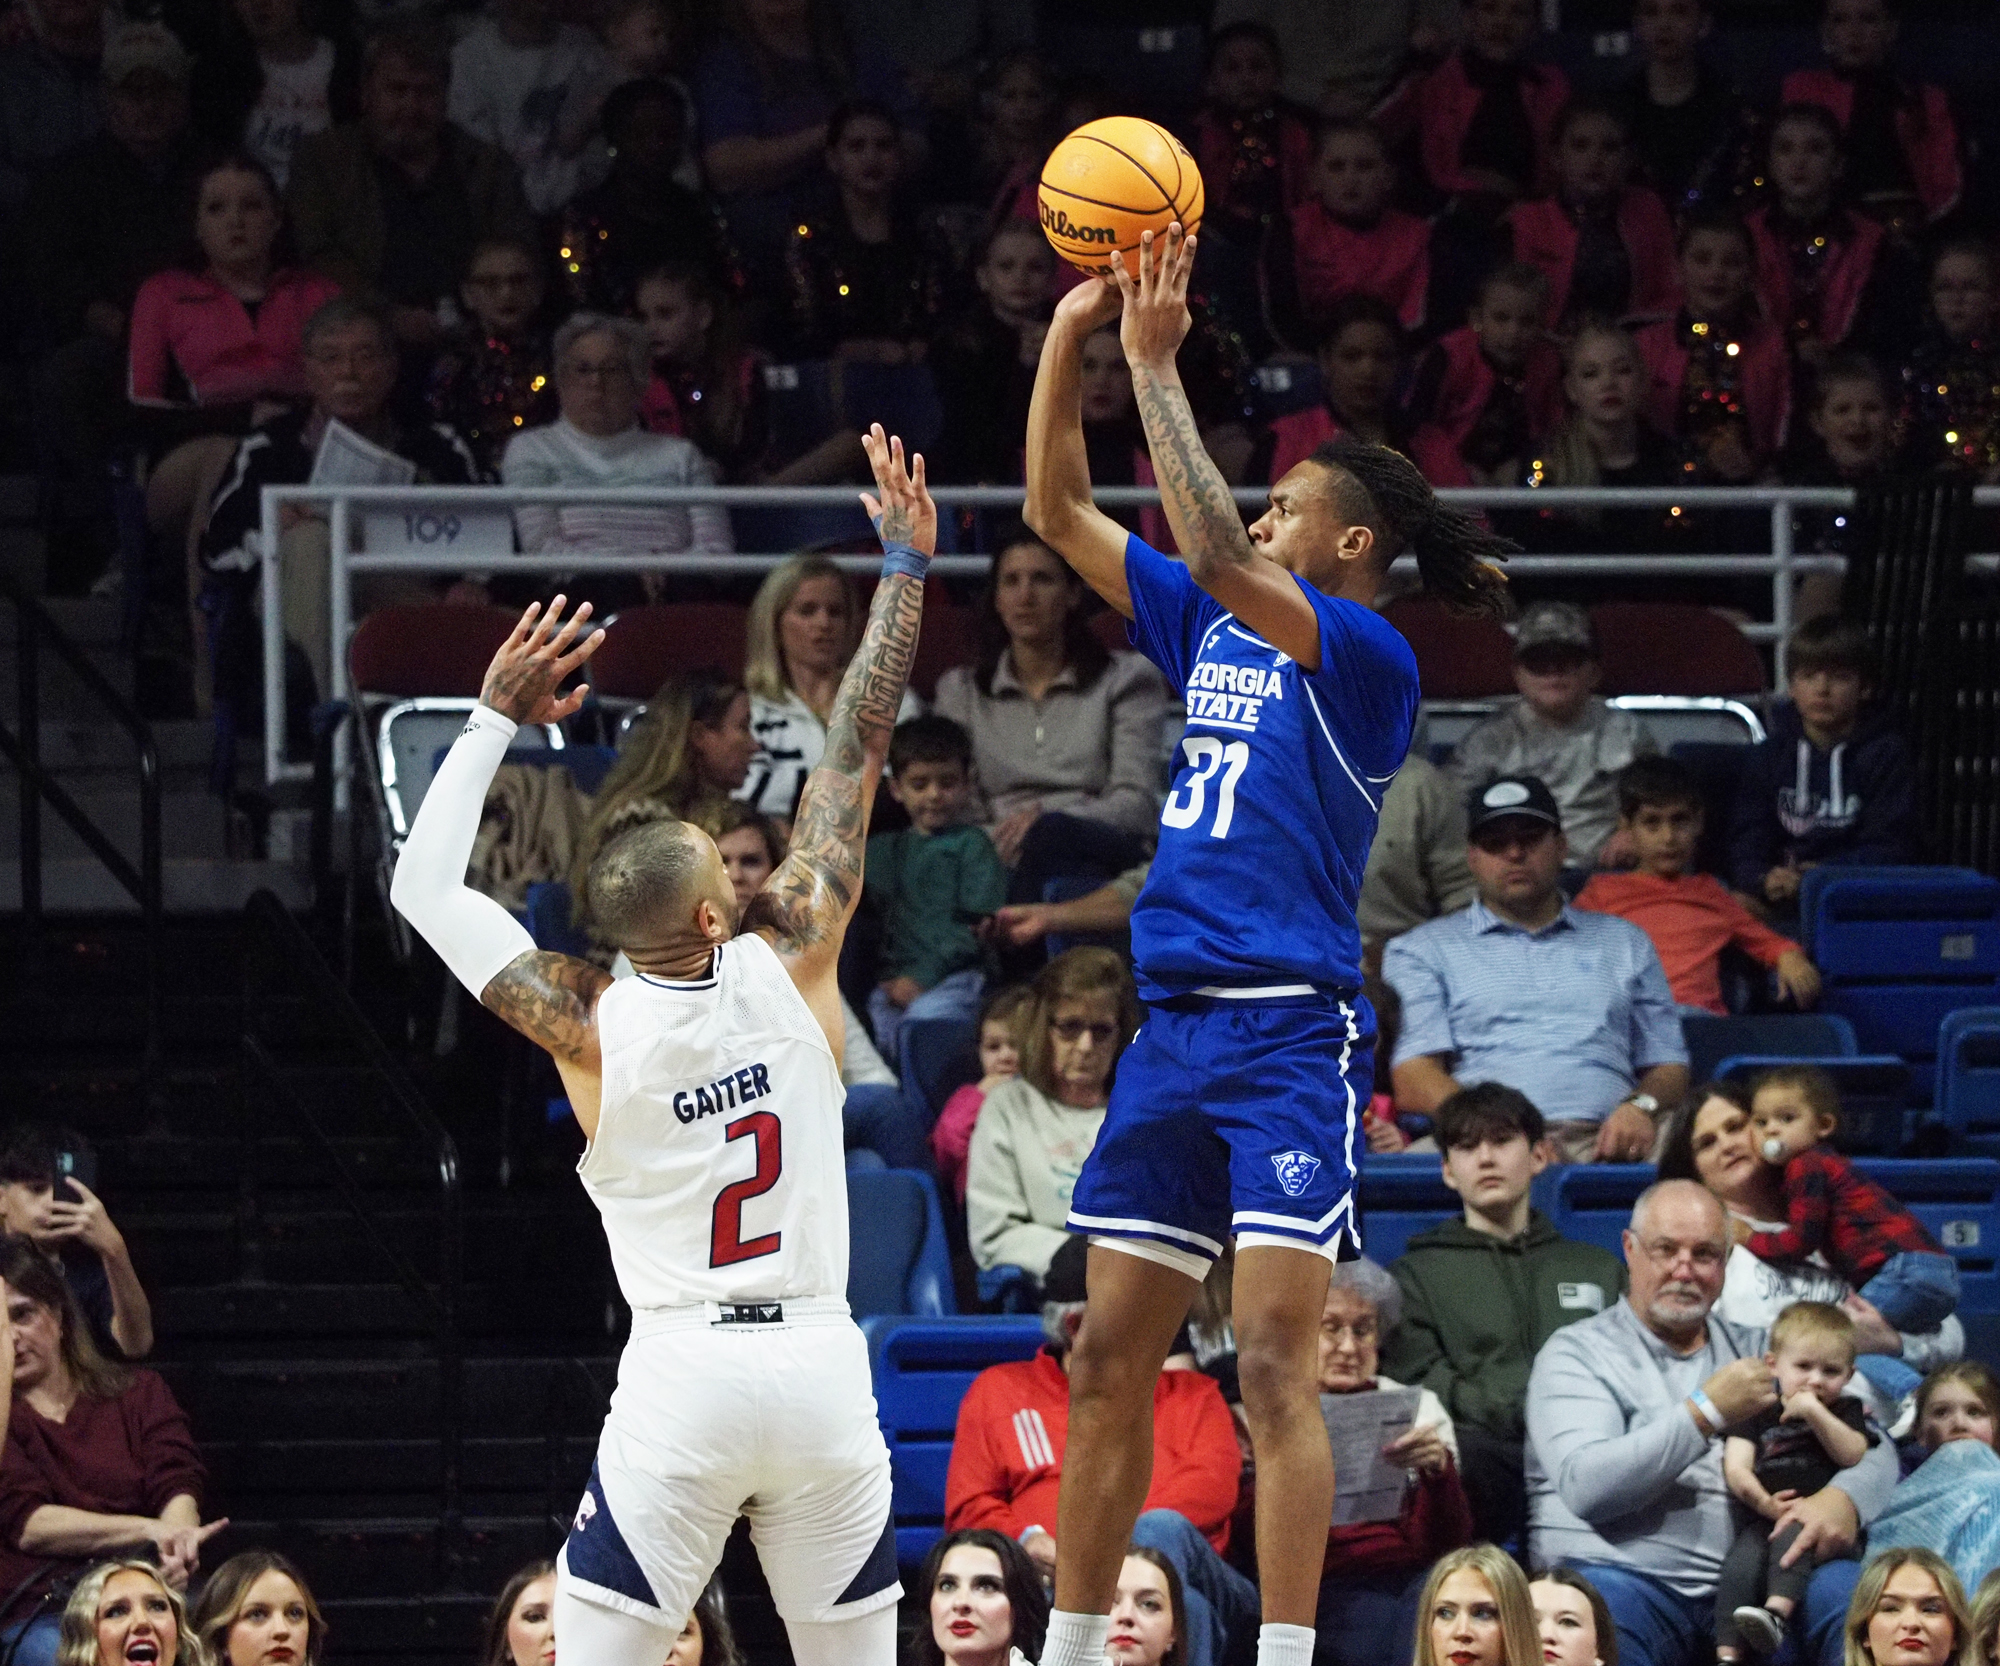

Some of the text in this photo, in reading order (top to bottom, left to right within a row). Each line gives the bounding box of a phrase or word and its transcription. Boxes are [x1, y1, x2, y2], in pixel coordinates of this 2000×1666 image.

[404, 514, 462, 546] 109
[1187, 662, 1283, 700] EORGIA
[1187, 690, 1263, 723] STATE
[1161, 736, 1249, 839] 31
[672, 1062, 771, 1125] GAITER
[709, 1110, 782, 1269] 2
